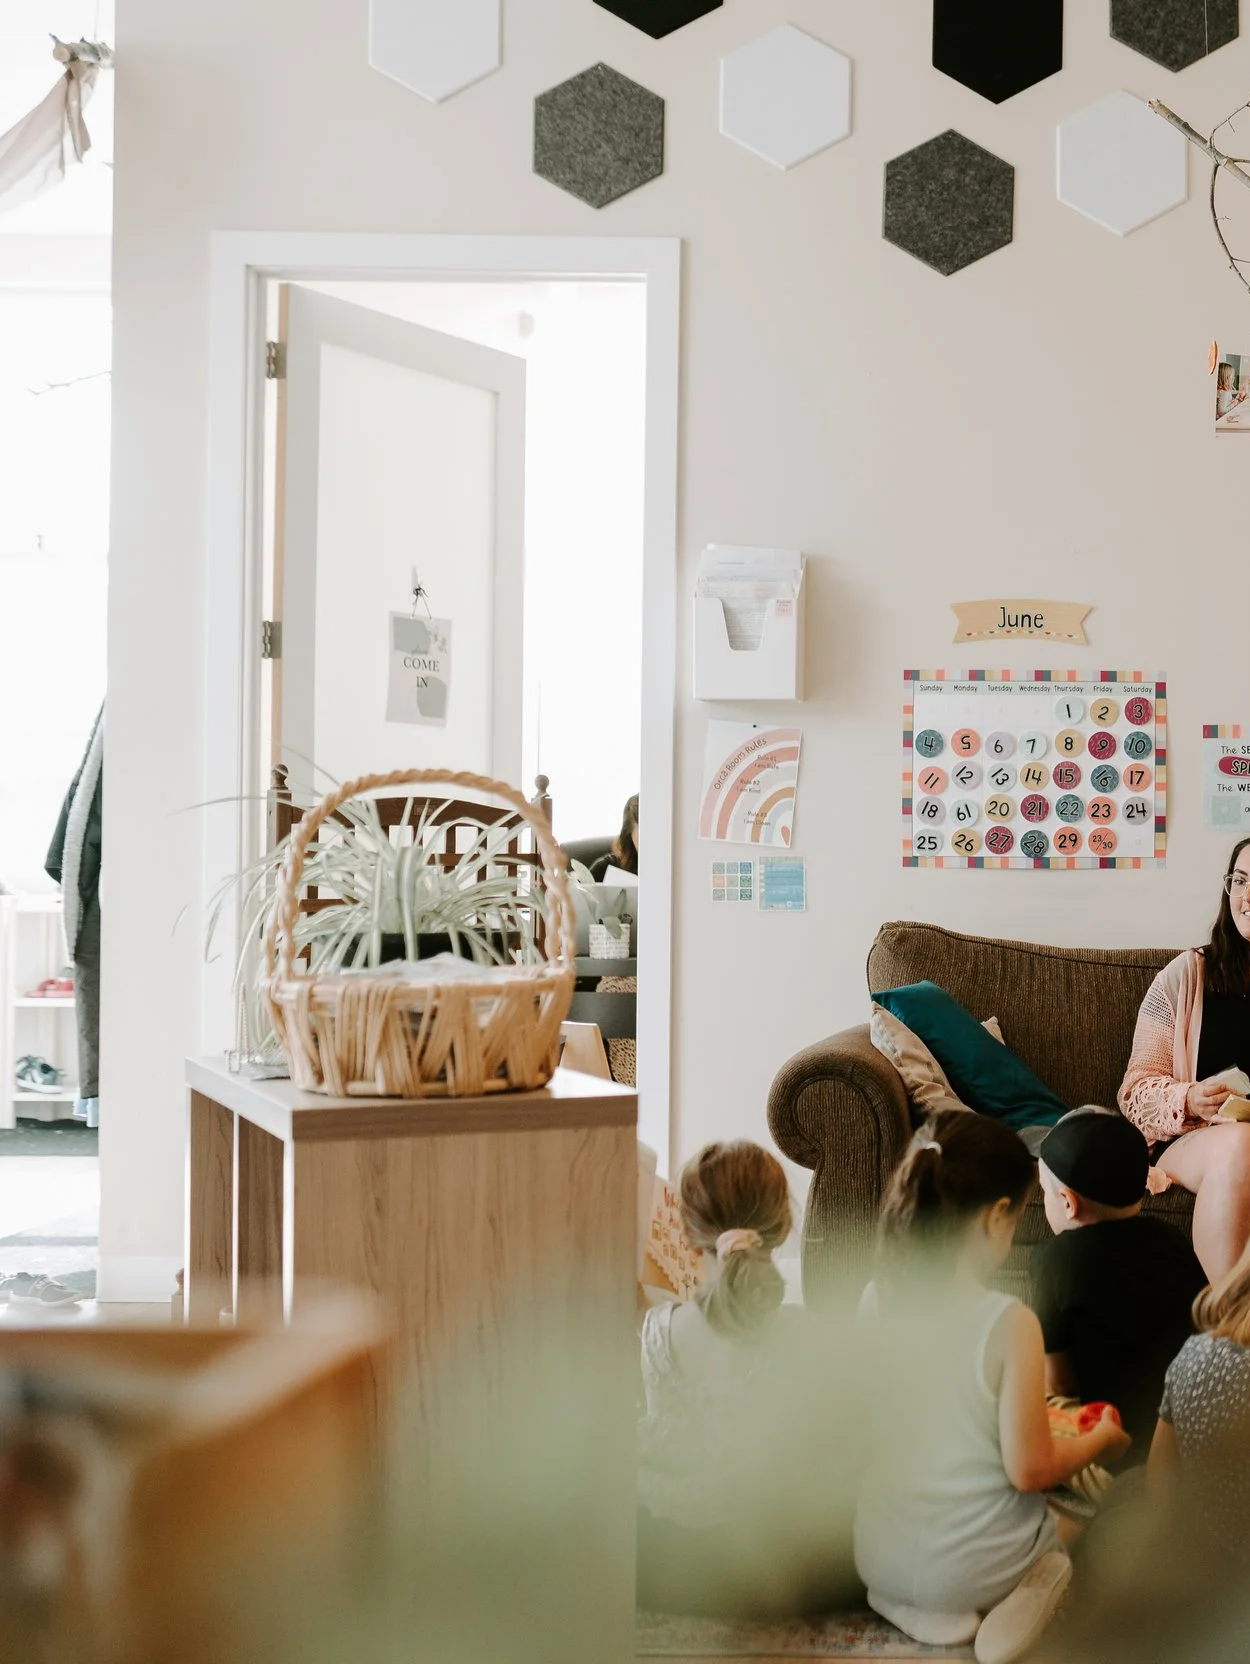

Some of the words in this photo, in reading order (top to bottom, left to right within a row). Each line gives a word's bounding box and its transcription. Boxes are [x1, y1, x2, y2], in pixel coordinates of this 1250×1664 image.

[998, 606, 1044, 629] June
[403, 656, 440, 672] COME
[416, 676, 428, 688] IN
[920, 684, 944, 692] Sunday
[1054, 685, 1084, 693] Thursday
[1098, 706, 1109, 720] 2
[1134, 704, 1143, 719] 3
[924, 736, 935, 752] 4
[961, 735, 971, 750] 5
[994, 739, 1004, 753] 6
[1026, 738, 1036, 754] 7
[1064, 736, 1074, 751] 8
[1097, 739, 1109, 751] 9
[1128, 737, 1146, 754] 10
[1221, 745, 1237, 754] The
[714, 767, 728, 790] Orca
[726, 751, 746, 772] Room
[744, 738, 767, 755] Rules
[924, 772, 940, 789] 11
[956, 765, 974, 785] 12
[991, 768, 1010, 786] 13
[1025, 768, 1042, 785] 14
[1059, 768, 1074, 783] 15
[1095, 769, 1112, 787] 16
[1129, 770, 1145, 785] 17
[1217, 783, 1233, 792] The
[921, 800, 939, 818] 18
[988, 800, 1010, 817] 20
[1027, 801, 1042, 816] 21
[1060, 801, 1079, 816] 22
[1091, 803, 1111, 818] 23
[1126, 802, 1147, 819] 24
[916, 835, 938, 851] 25
[954, 834, 974, 852] 26
[988, 832, 1011, 848] 27
[1023, 835, 1045, 854] 28
[1058, 833, 1078, 848] 29
